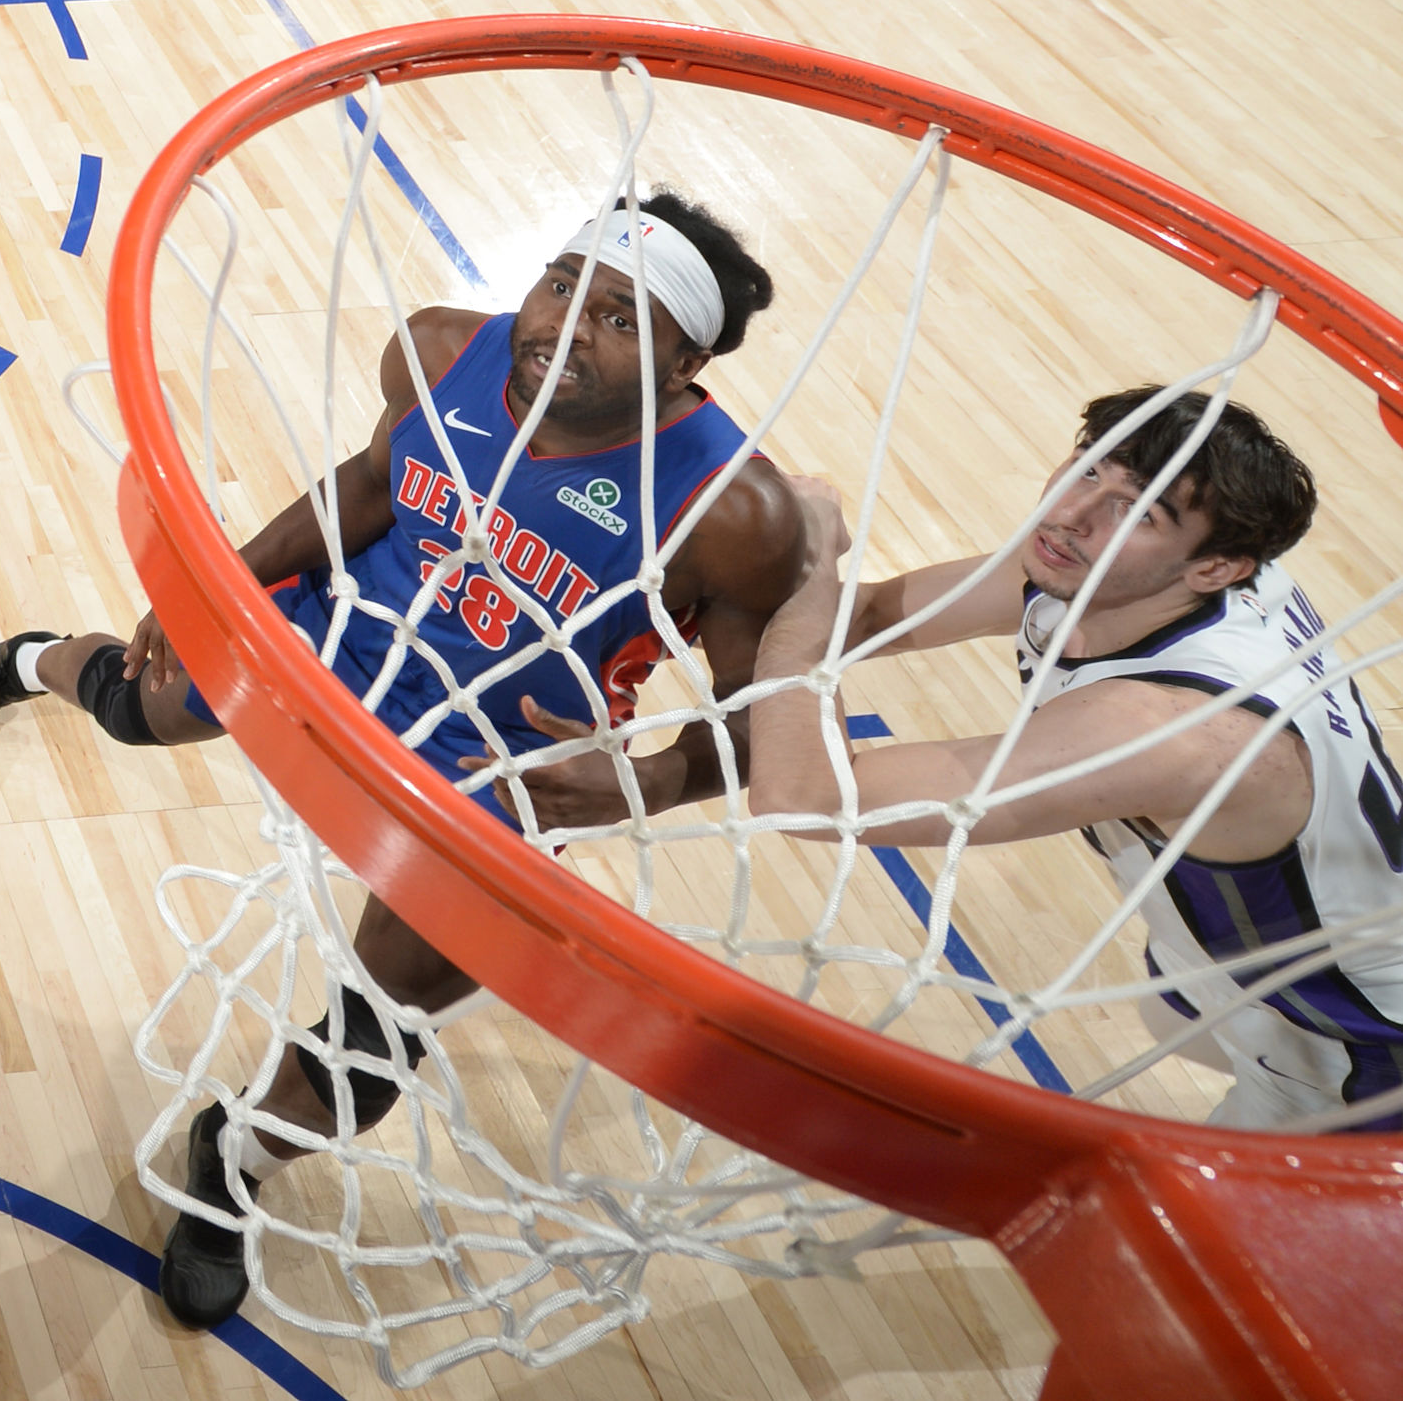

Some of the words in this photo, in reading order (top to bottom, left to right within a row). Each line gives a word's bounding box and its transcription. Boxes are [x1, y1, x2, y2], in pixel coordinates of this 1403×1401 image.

[397, 456, 599, 618] DETROIT
[560, 488, 626, 533] StockX
[419, 538, 521, 650] 28
